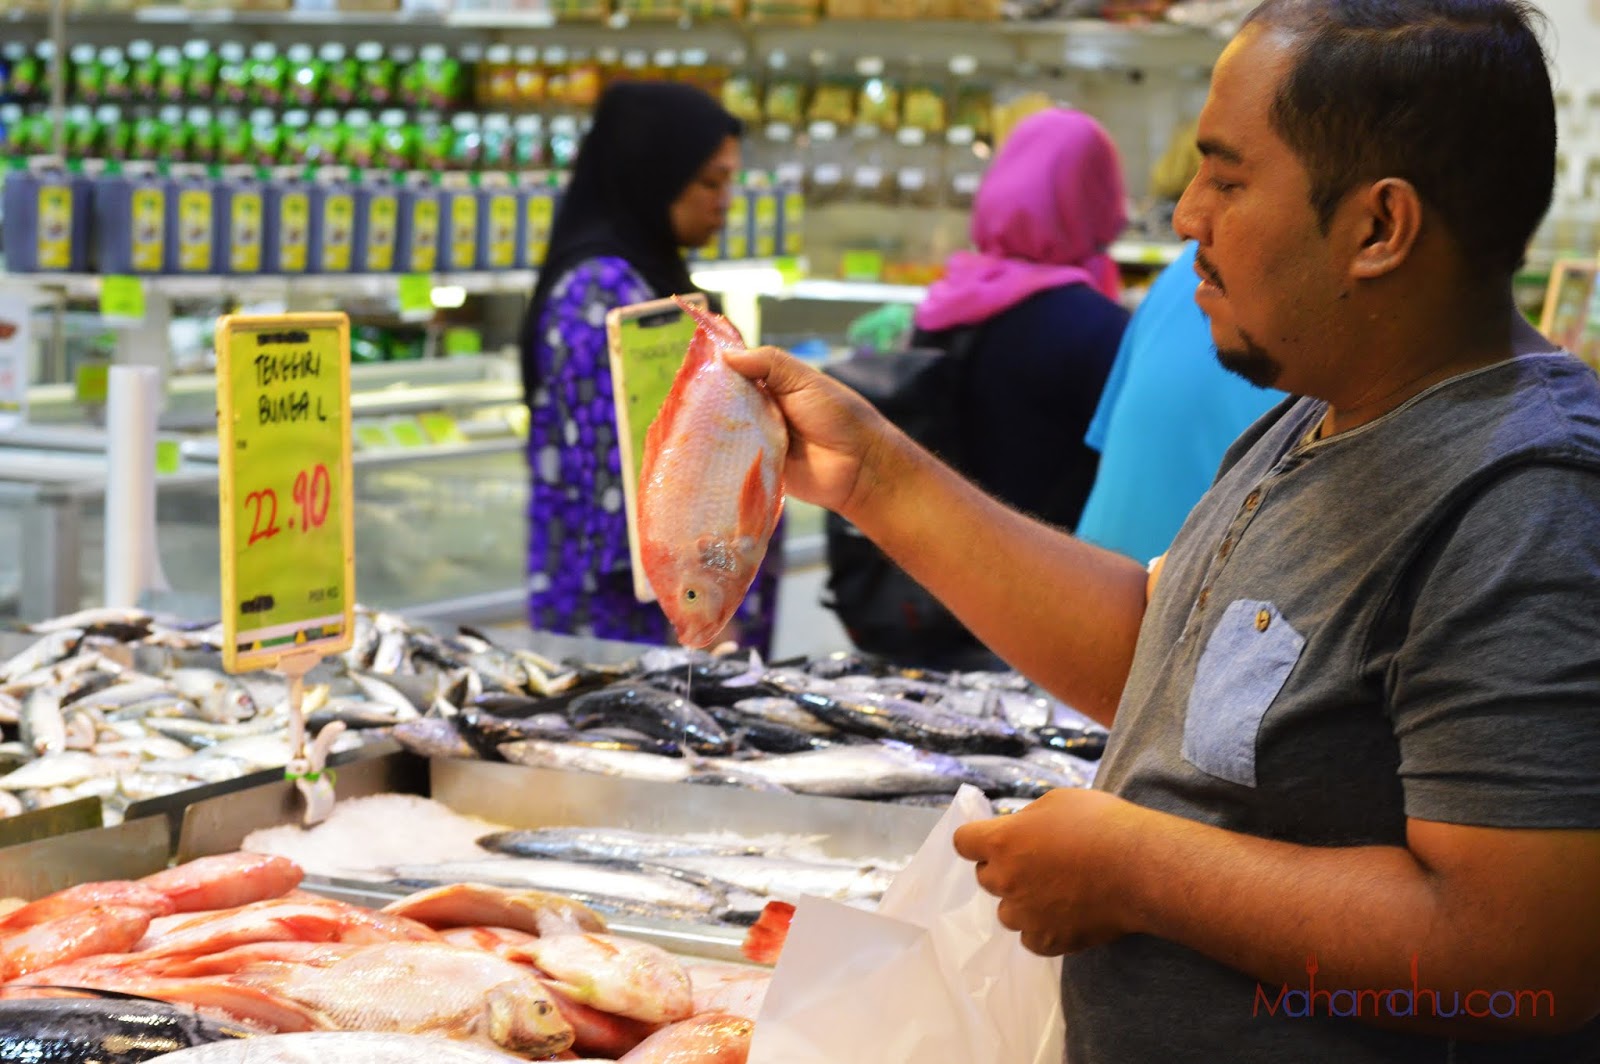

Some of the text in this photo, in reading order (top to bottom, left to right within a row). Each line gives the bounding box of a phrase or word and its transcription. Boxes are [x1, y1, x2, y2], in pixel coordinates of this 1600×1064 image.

[258, 391, 327, 427] BUNGA L
[244, 462, 330, 546] 22.90
